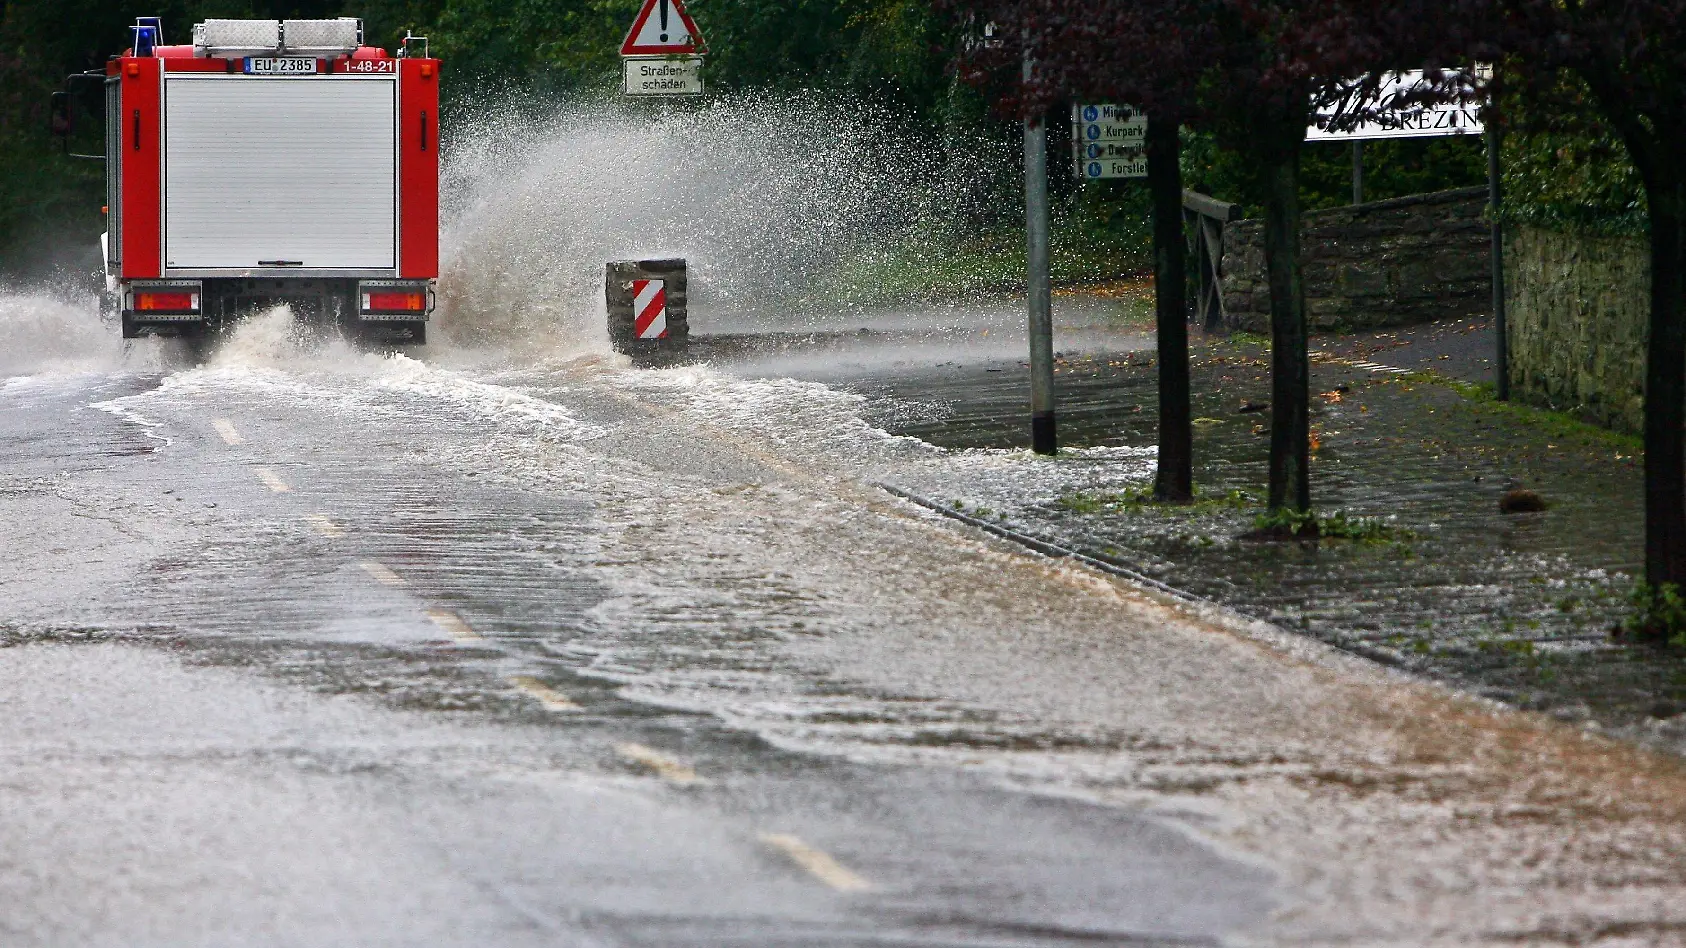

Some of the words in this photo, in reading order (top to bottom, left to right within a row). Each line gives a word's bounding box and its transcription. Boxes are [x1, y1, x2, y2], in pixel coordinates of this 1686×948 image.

[254, 59, 272, 71] EU
[280, 59, 312, 71] 2385
[344, 61, 393, 72] 1-48-21
[640, 65, 688, 77] Straßen-
[642, 79, 686, 90] schäden
[1106, 125, 1143, 139] Kurpark
